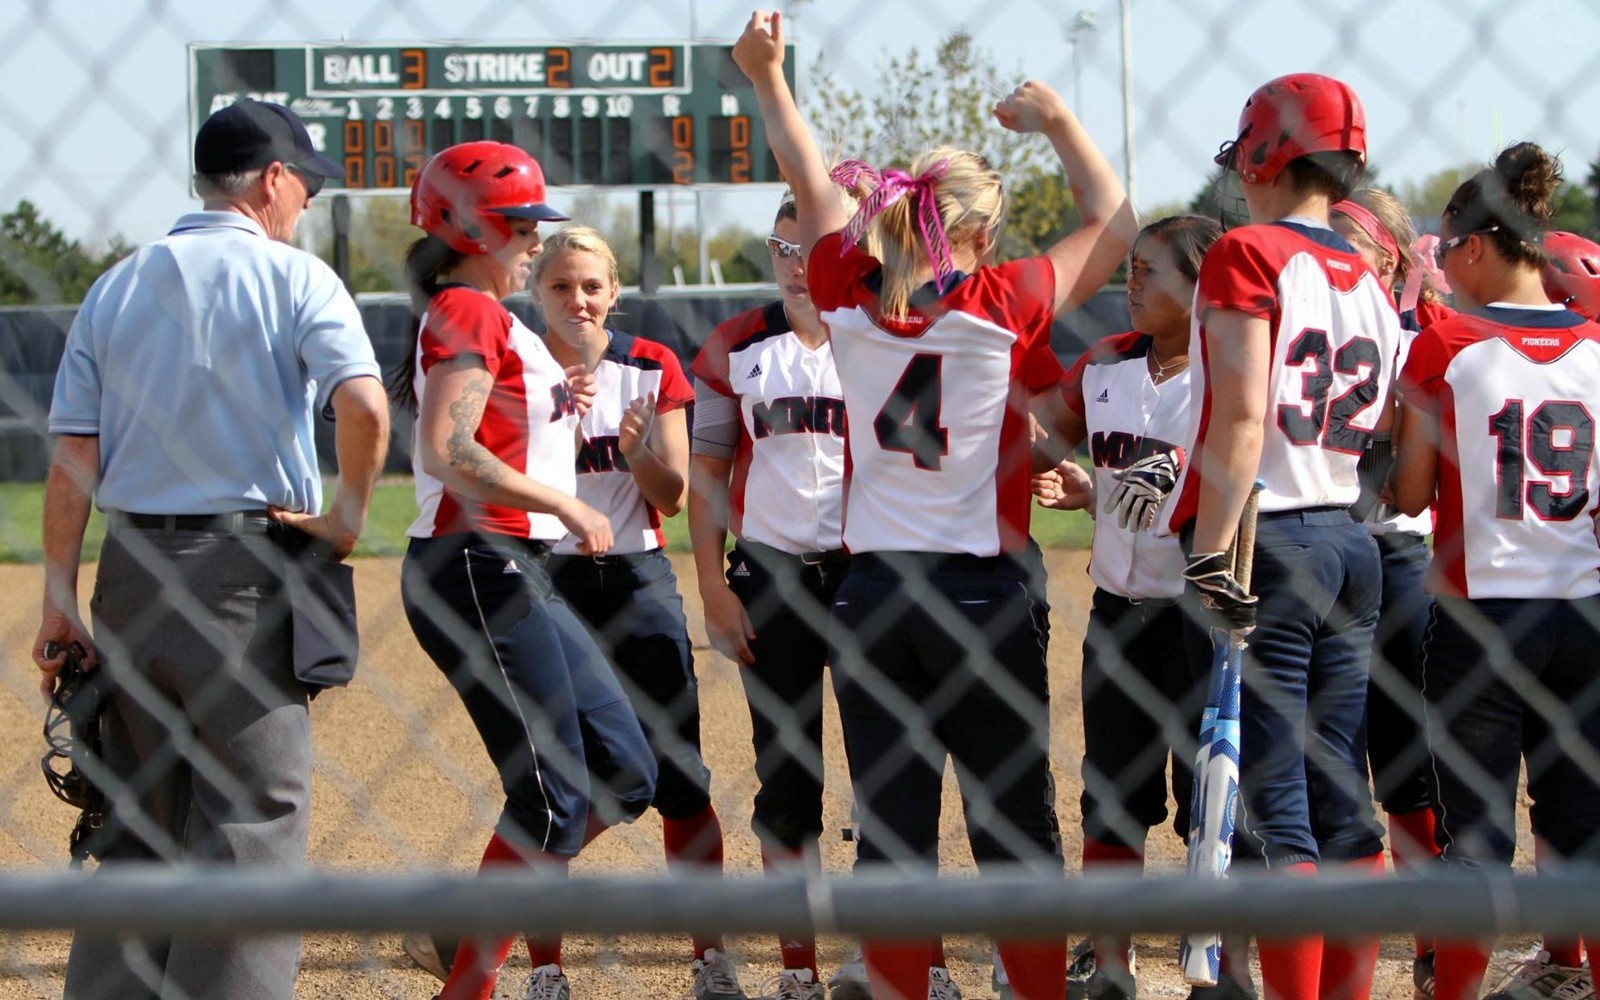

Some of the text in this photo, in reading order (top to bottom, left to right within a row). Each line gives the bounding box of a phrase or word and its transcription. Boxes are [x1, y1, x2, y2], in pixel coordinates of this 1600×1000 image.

[323, 48, 673, 89] BALL 3 STRIKE 2 OUT 2
[346, 98, 361, 119] 1
[376, 98, 394, 119] 2
[406, 97, 424, 119] 3
[434, 97, 451, 118] 4
[465, 97, 483, 119] 5
[494, 96, 512, 119] 6
[525, 97, 540, 118] 7
[553, 96, 570, 117] 8
[581, 96, 599, 117] 9
[606, 95, 633, 117] 10
[344, 120, 364, 152] 0
[374, 120, 393, 152] 0
[672, 116, 693, 149] 0
[730, 116, 750, 148] 0
[344, 155, 365, 188] 0
[374, 155, 395, 188] 0
[673, 151, 694, 185] 2
[730, 151, 750, 183] 2
[1521, 337, 1560, 347] PIONEERS
[1276, 327, 1382, 457] 32
[873, 353, 948, 471] 4
[1488, 398, 1596, 521] 19
